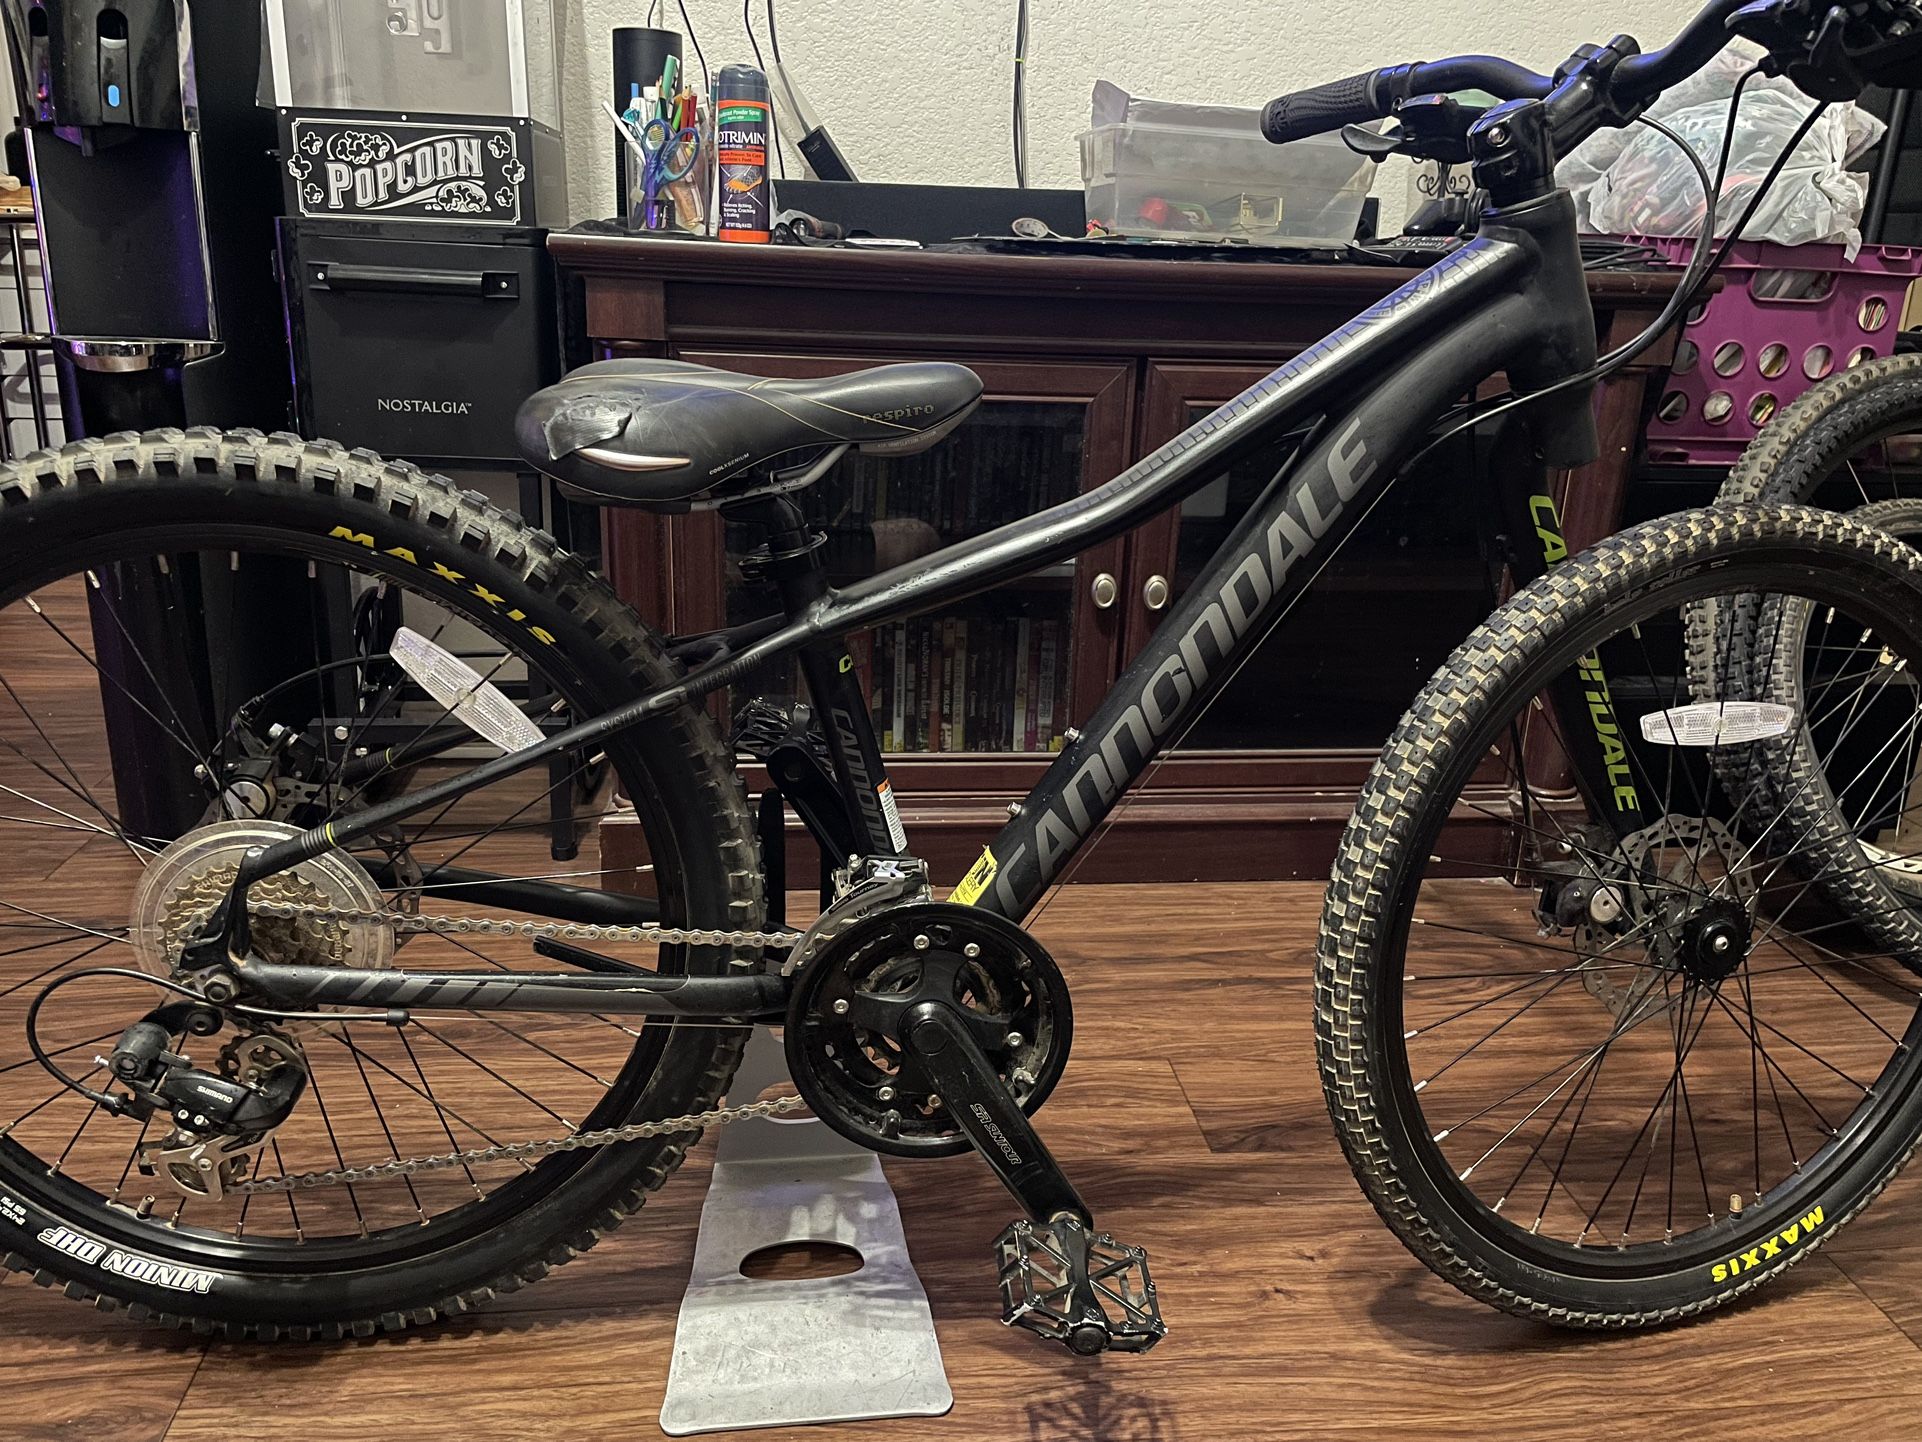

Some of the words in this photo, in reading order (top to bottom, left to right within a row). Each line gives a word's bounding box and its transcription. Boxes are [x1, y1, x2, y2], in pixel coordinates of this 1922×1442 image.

[719, 130, 765, 145] OTRIMIN
[324, 137, 484, 209] POPCORN
[328, 525, 557, 646] MAXXIS
[600, 705, 645, 732] SYSTEM
[689, 652, 762, 695] INTEGRATION
[850, 883, 879, 899] Tourney
[196, 1085, 233, 1104] SHIMANO
[984, 1122, 1022, 1165] SUNTOUR
[37, 1226, 107, 1265] DHF
[1711, 1205, 1825, 1283] MAXXIS
[101, 1249, 224, 1294] MINION
